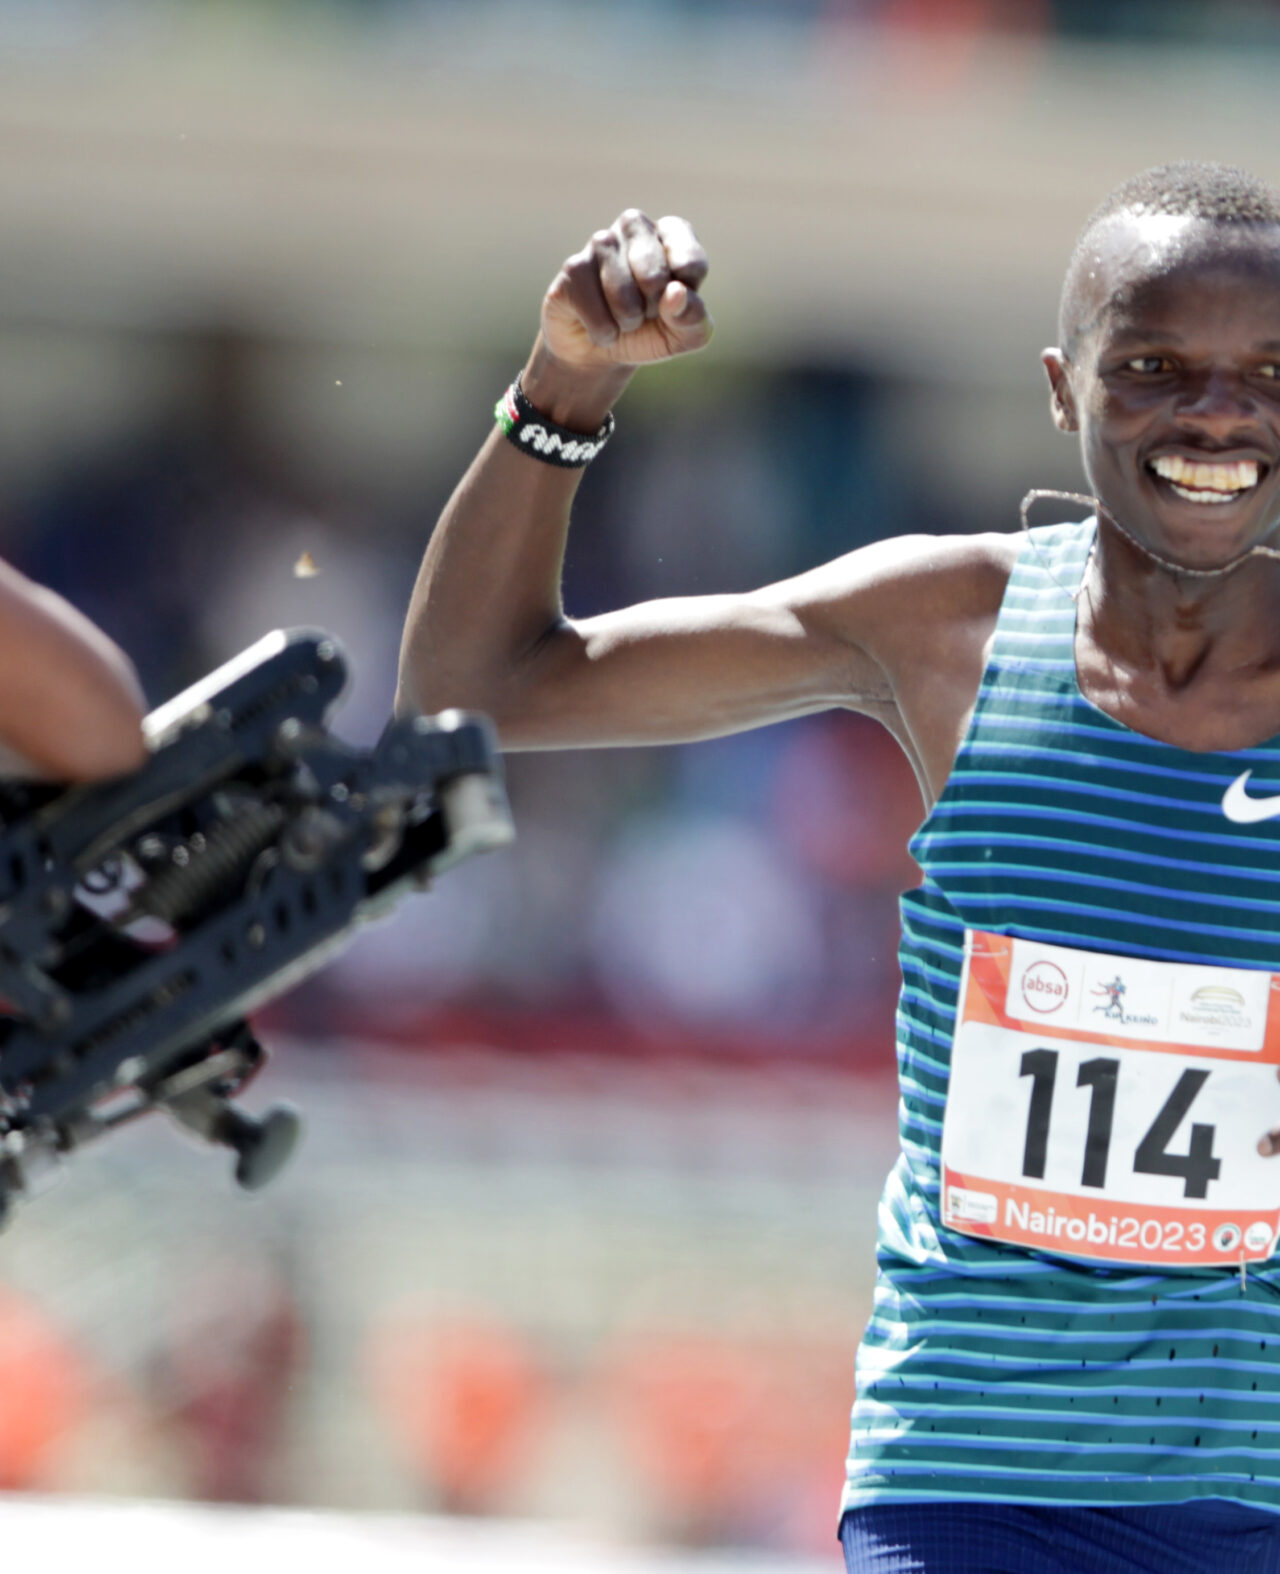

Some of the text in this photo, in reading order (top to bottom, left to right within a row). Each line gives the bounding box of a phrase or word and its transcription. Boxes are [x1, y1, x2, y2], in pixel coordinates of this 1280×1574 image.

[1026, 974, 1063, 996] absa
[1019, 1048, 1222, 1200] 114
[1005, 1197, 1206, 1252] Nairobi2023
